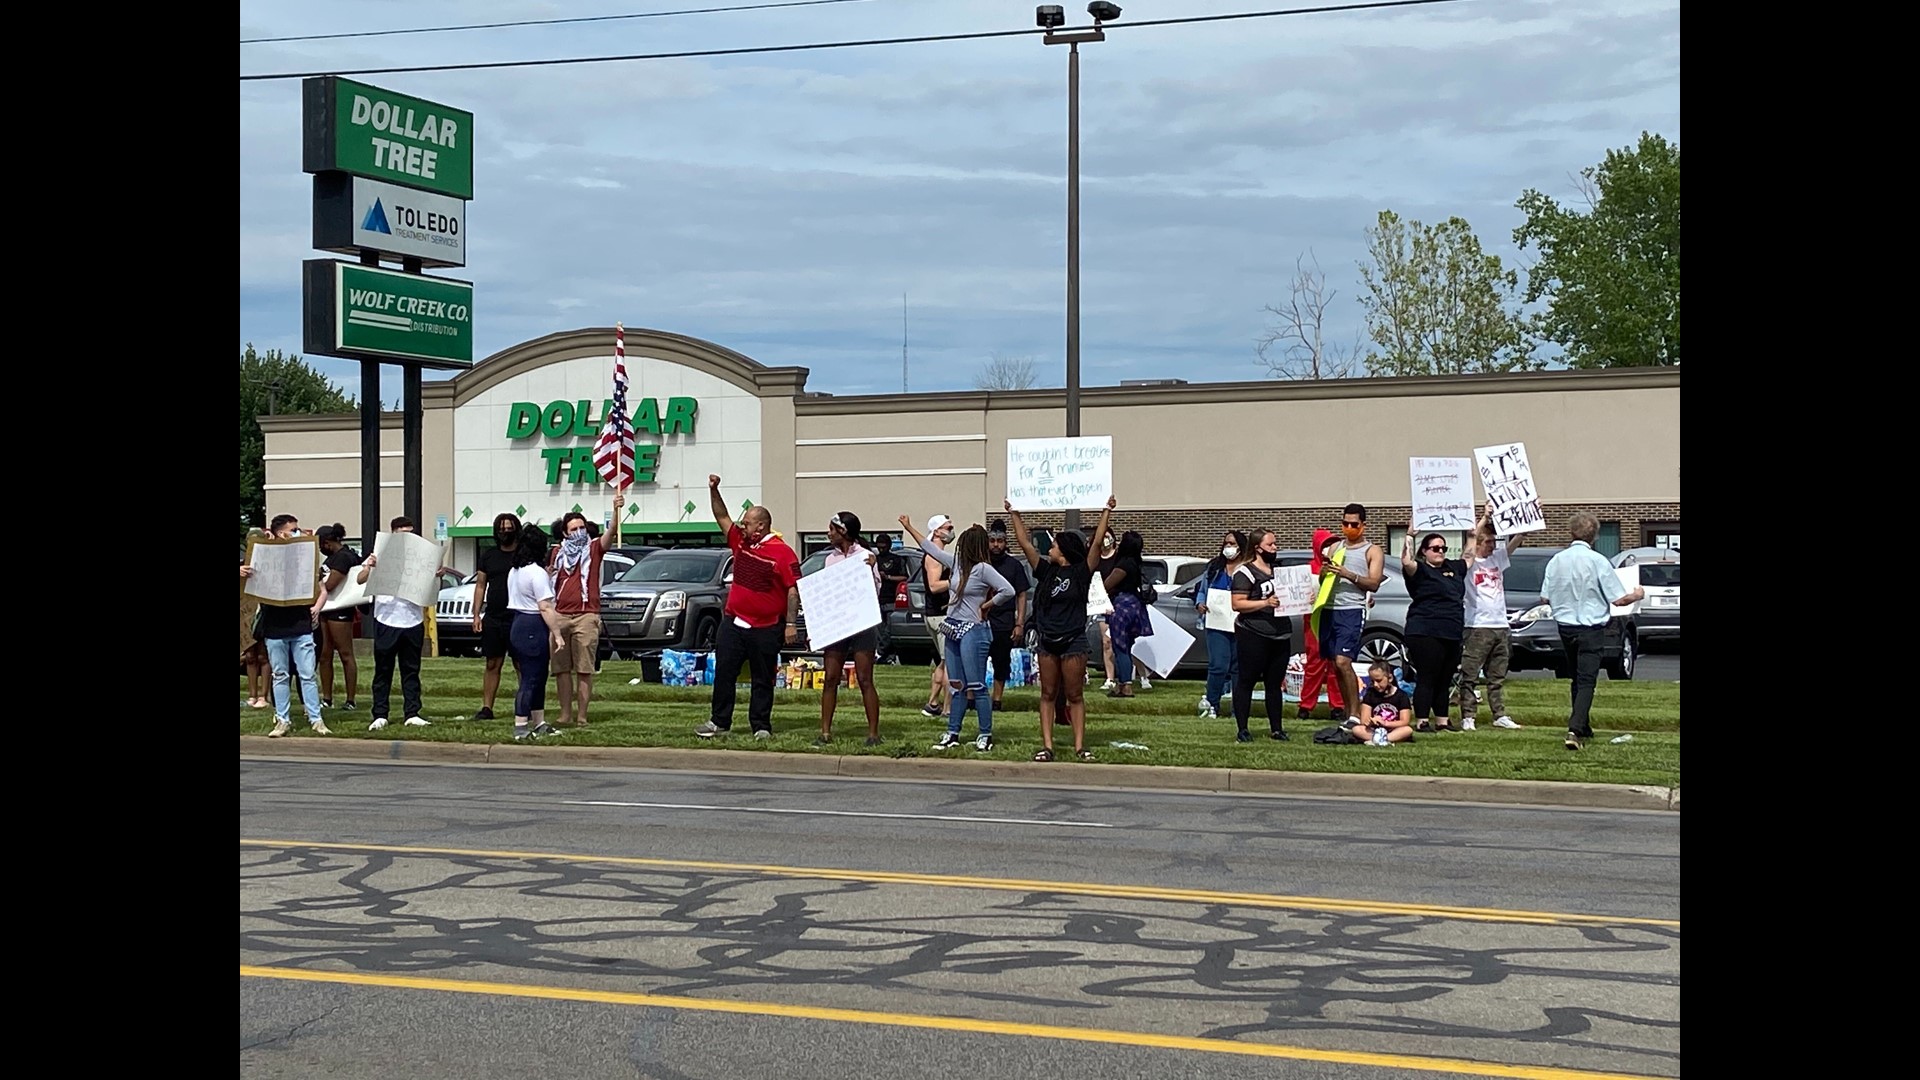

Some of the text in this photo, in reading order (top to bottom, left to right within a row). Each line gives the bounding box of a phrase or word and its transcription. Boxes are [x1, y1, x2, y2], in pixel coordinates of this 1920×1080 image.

[351, 94, 458, 149] DOLLAR
[371, 136, 438, 180] TREE
[395, 205, 459, 236] TOLEDO
[395, 227, 459, 248] TREATMENT SERVICES
[349, 287, 469, 323] WOLF CREEK CO.
[412, 320, 458, 336] DISTRIBUTION
[541, 444, 661, 485] TRE
[1010, 444, 1025, 462] He
[1057, 461, 1095, 475] minutes
[1071, 482, 1103, 497] happen
